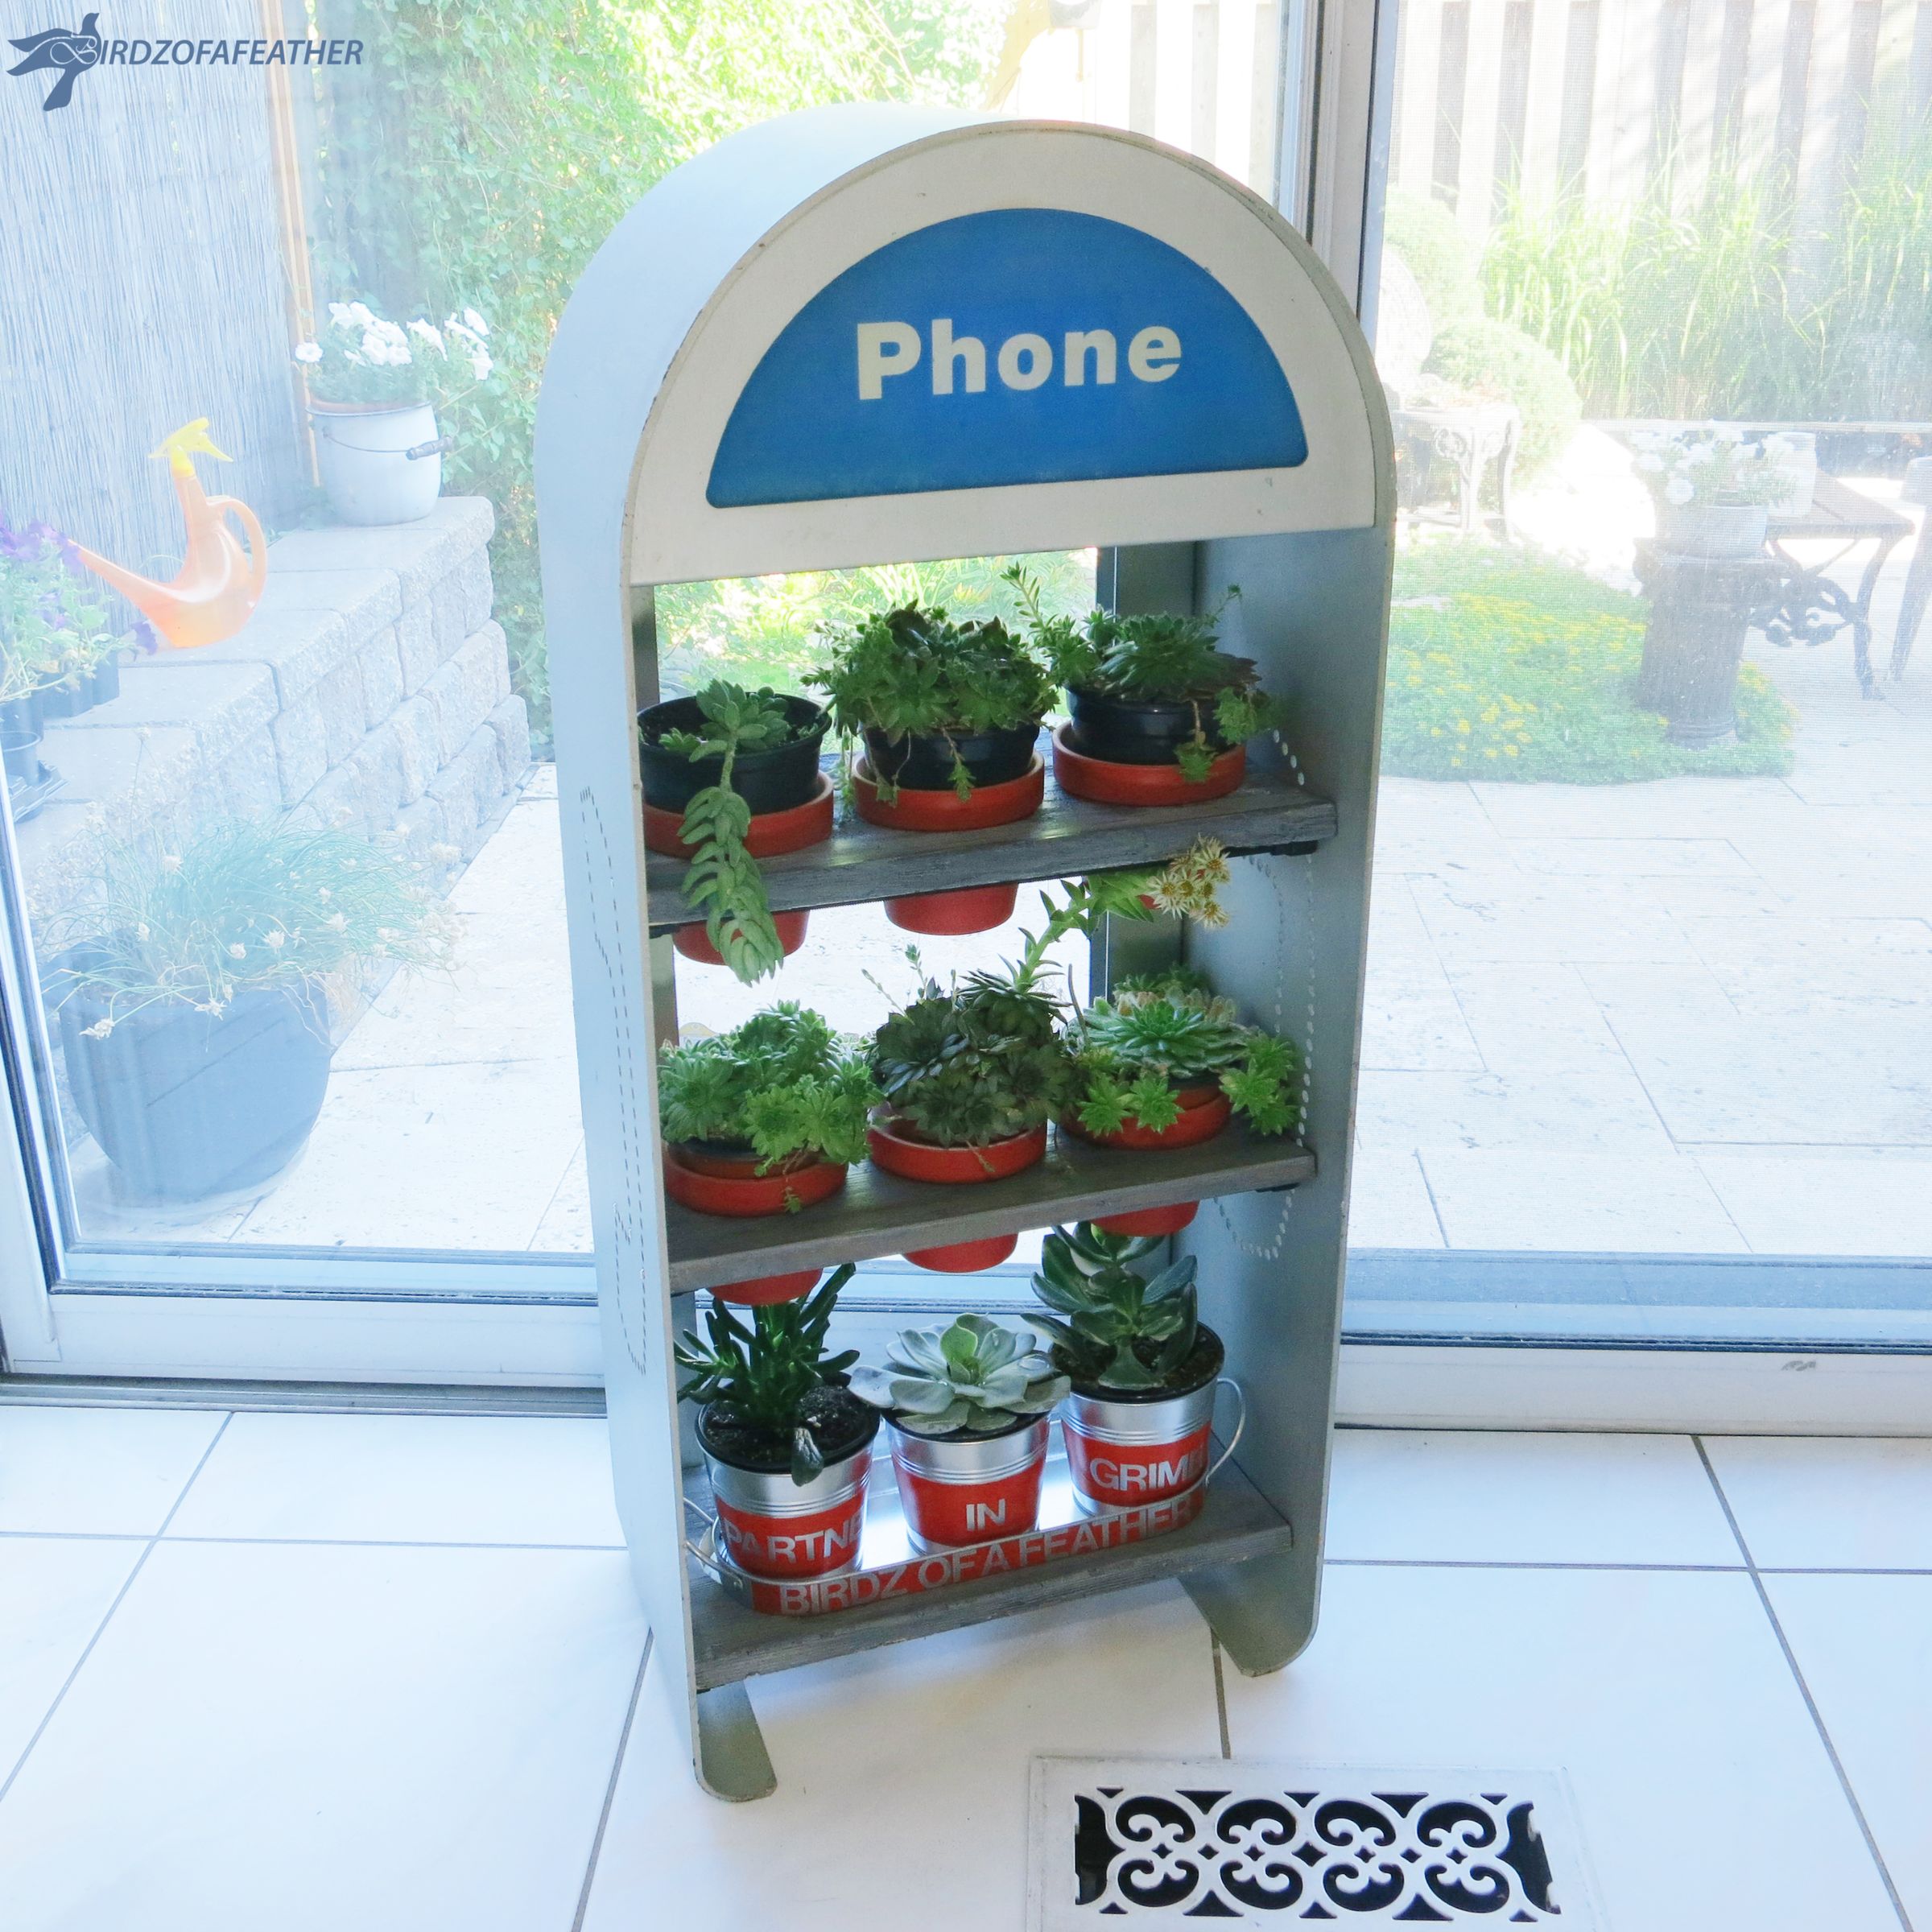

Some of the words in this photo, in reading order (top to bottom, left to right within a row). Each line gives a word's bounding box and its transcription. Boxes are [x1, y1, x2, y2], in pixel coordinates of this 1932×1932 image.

[857, 318, 1182, 400] Phone
[966, 1498, 1006, 1530] IN
[780, 1567, 908, 1615] BIRDZ
[918, 1546, 976, 1589] OF
[980, 1542, 1010, 1576] A
[1018, 1496, 1193, 1568] FEATHER
